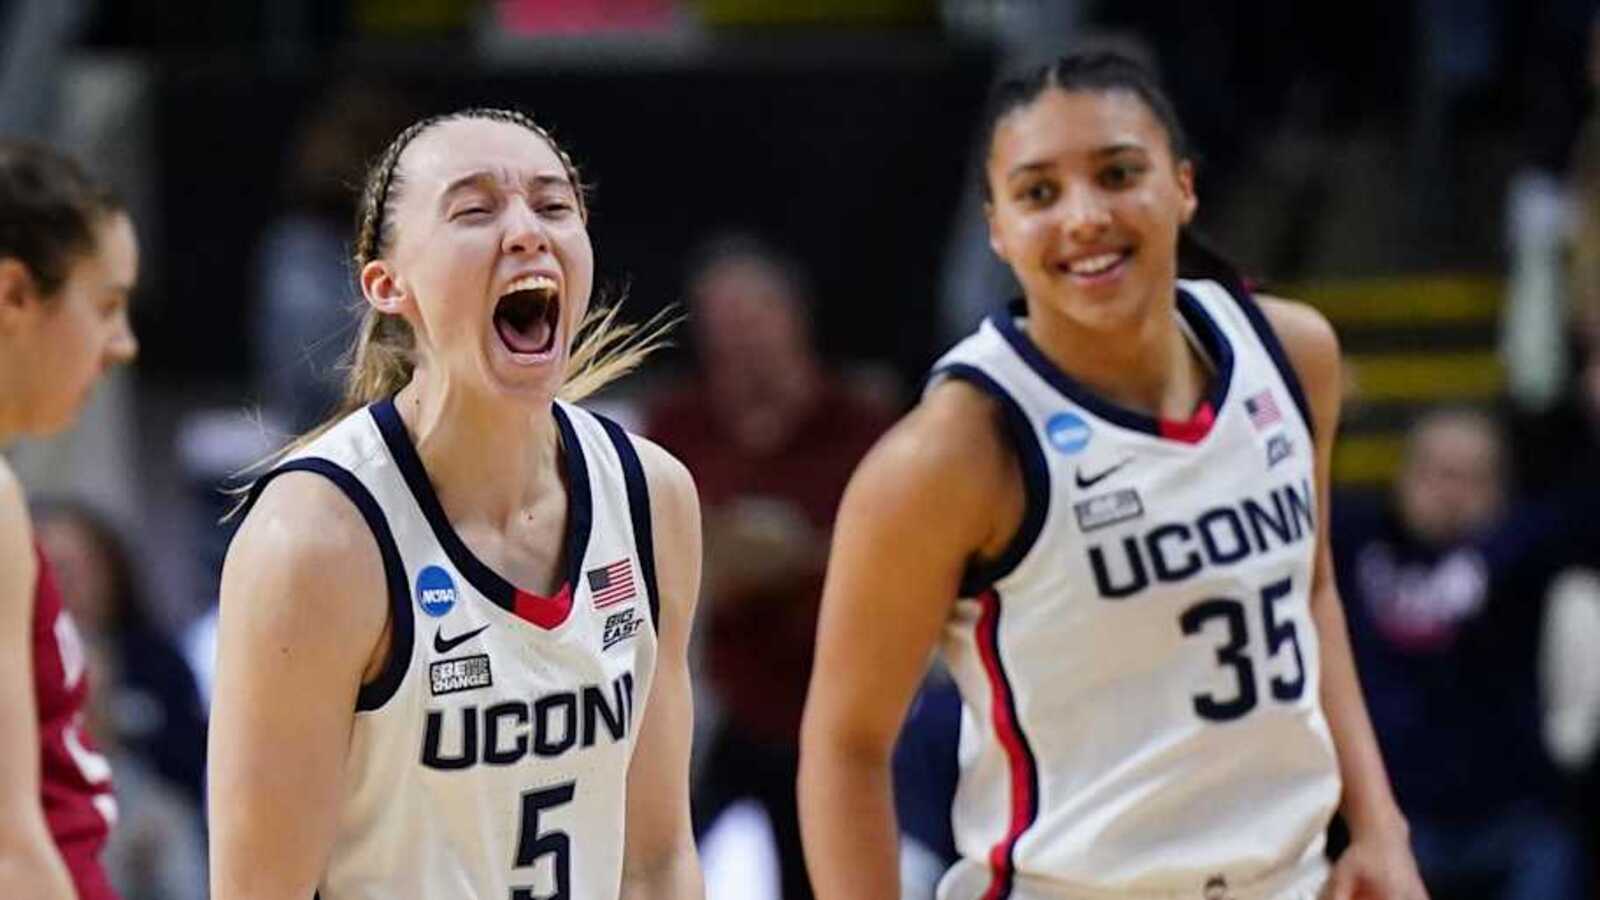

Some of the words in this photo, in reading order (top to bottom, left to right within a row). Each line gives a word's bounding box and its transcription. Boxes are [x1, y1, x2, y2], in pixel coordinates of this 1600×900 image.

[420, 588, 456, 605] NCAA
[604, 607, 634, 629] BIG
[603, 618, 645, 643] EAST
[1180, 577, 1305, 723] 35
[432, 673, 490, 693] CHANGE
[509, 779, 576, 900] 5
